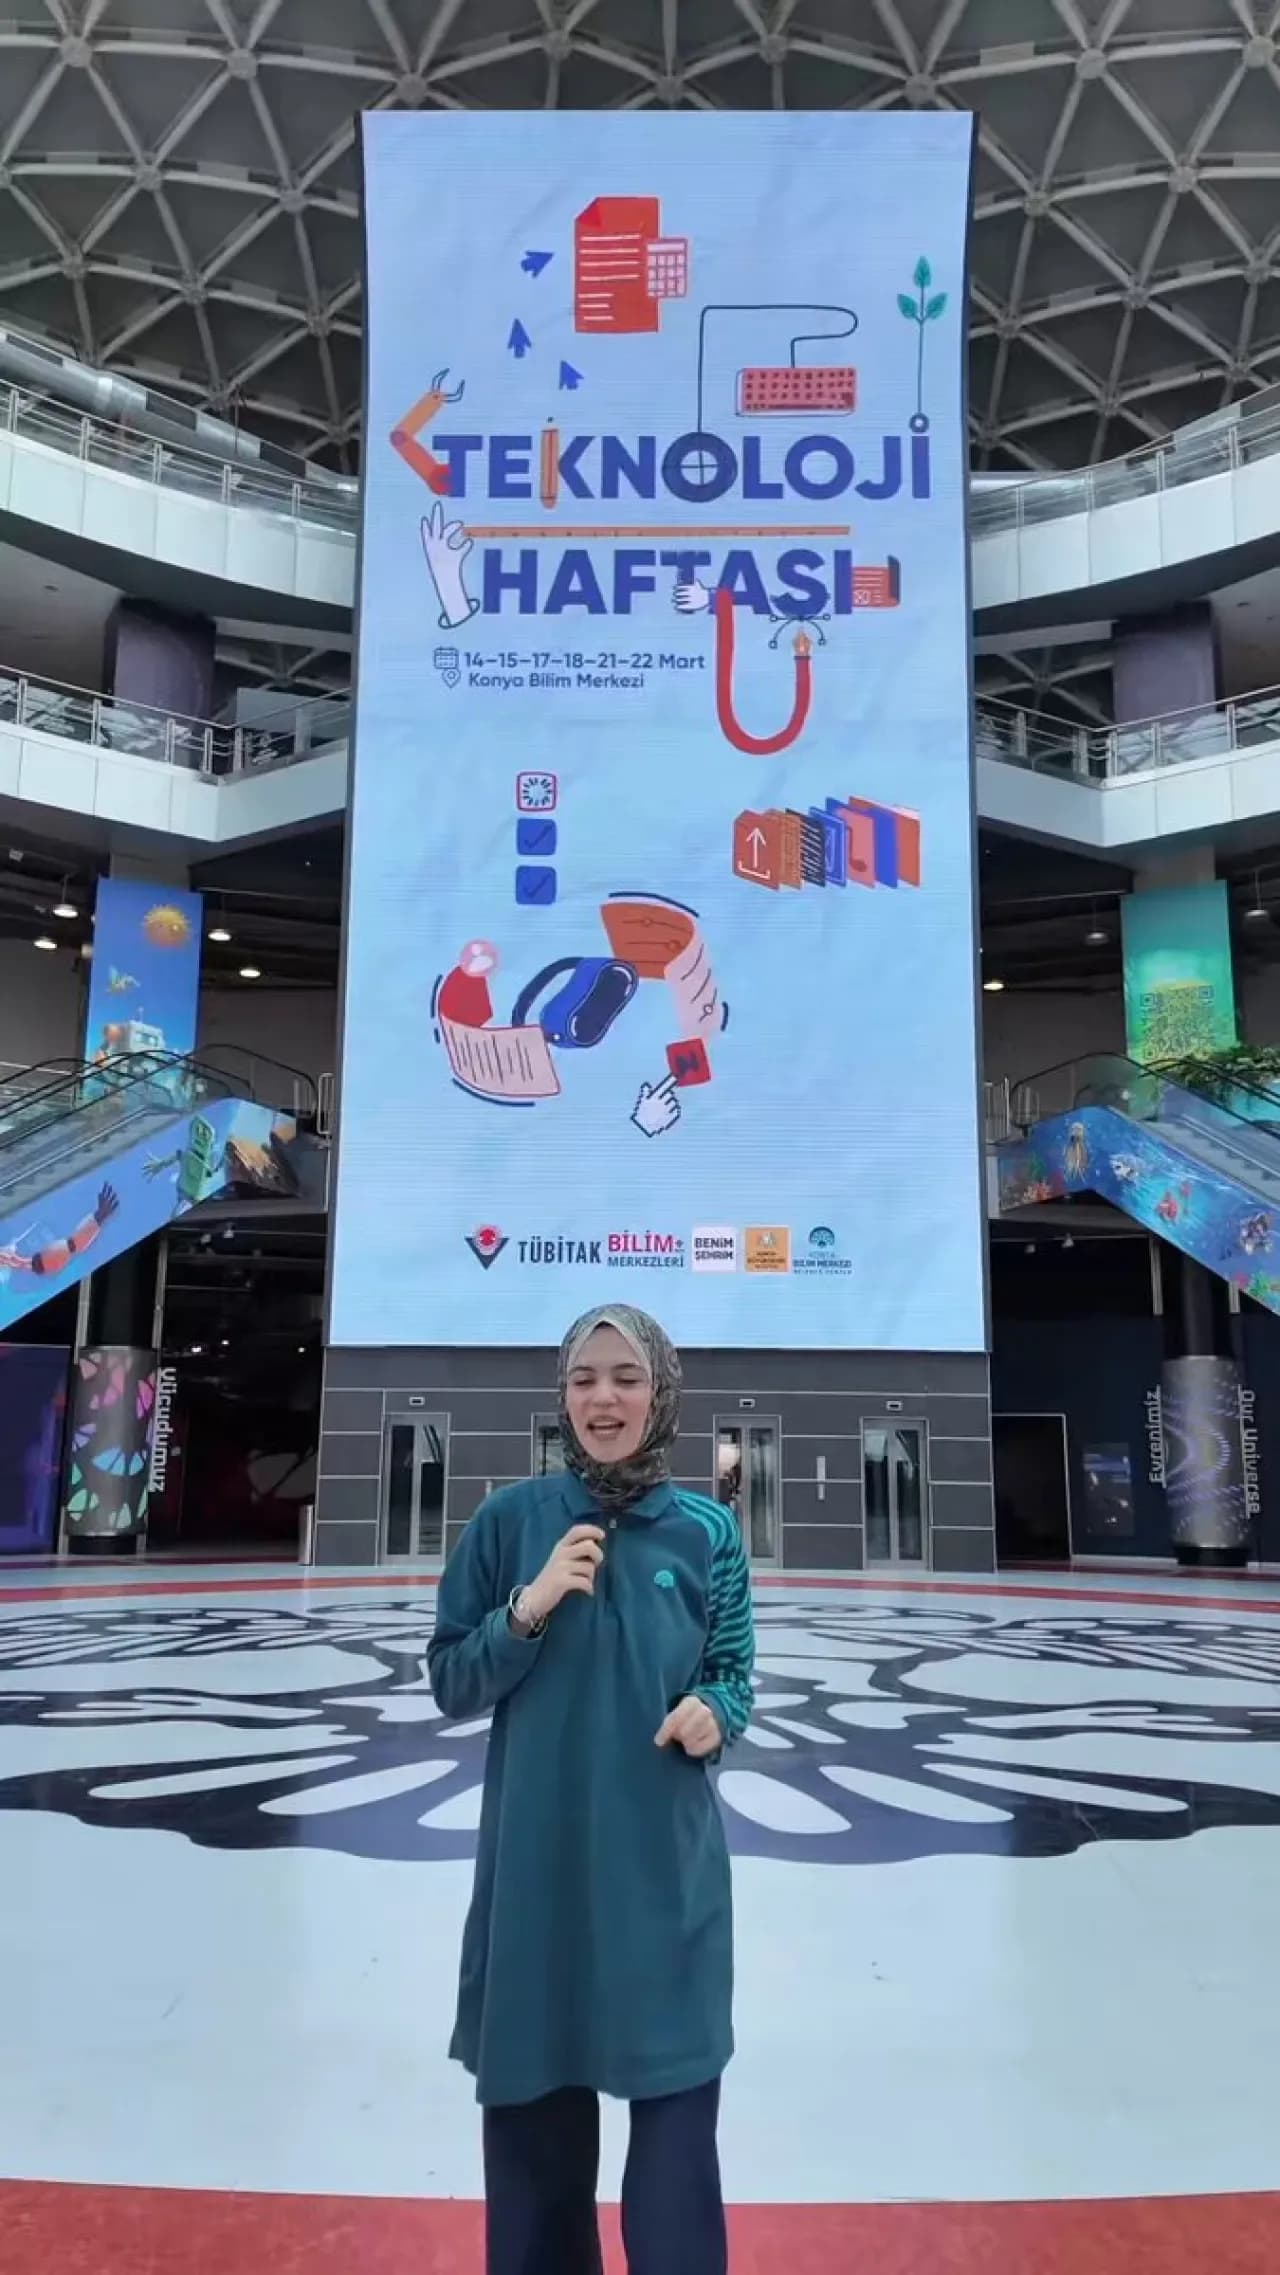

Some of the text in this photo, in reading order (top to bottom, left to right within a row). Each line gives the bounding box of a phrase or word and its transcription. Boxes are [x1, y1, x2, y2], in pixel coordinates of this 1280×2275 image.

[432, 417, 931, 505] TEKNOLOJİ
[482, 548, 853, 616] HAFTASI
[659, 653, 706, 669] Mart
[468, 671, 645, 690] Konya Bilim Merkezi
[517, 1235, 602, 1264] TÜBİTAK
[607, 1229, 673, 1253] BİLİM
[607, 1254, 685, 1268] MERKEZLERİ
[1144, 1390, 1164, 1484] Evrenimiz
[1241, 1389, 1260, 1514] Our Universe
